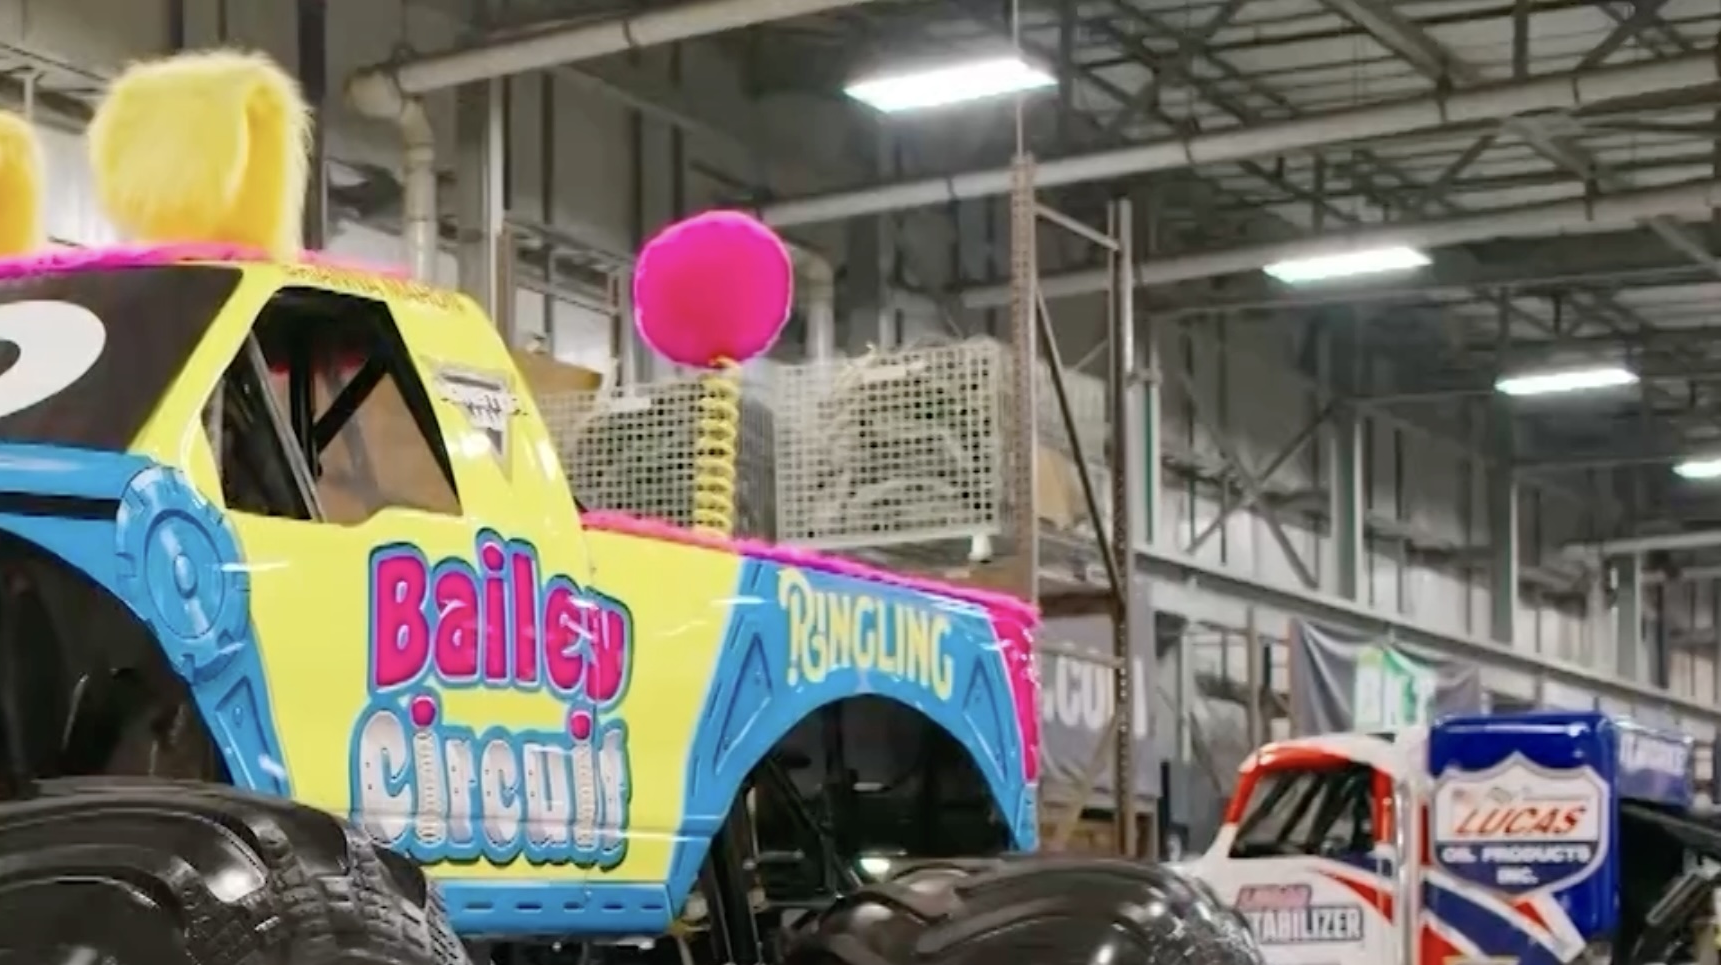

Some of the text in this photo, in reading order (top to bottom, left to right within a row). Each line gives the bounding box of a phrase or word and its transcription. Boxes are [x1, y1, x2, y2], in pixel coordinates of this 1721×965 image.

[371, 538, 629, 706] Bailey
[776, 567, 956, 701] RINGLING
[355, 695, 626, 858] Circuit
[1454, 805, 1587, 836] LUCAS
[1243, 908, 1361, 940] TABILIZER
